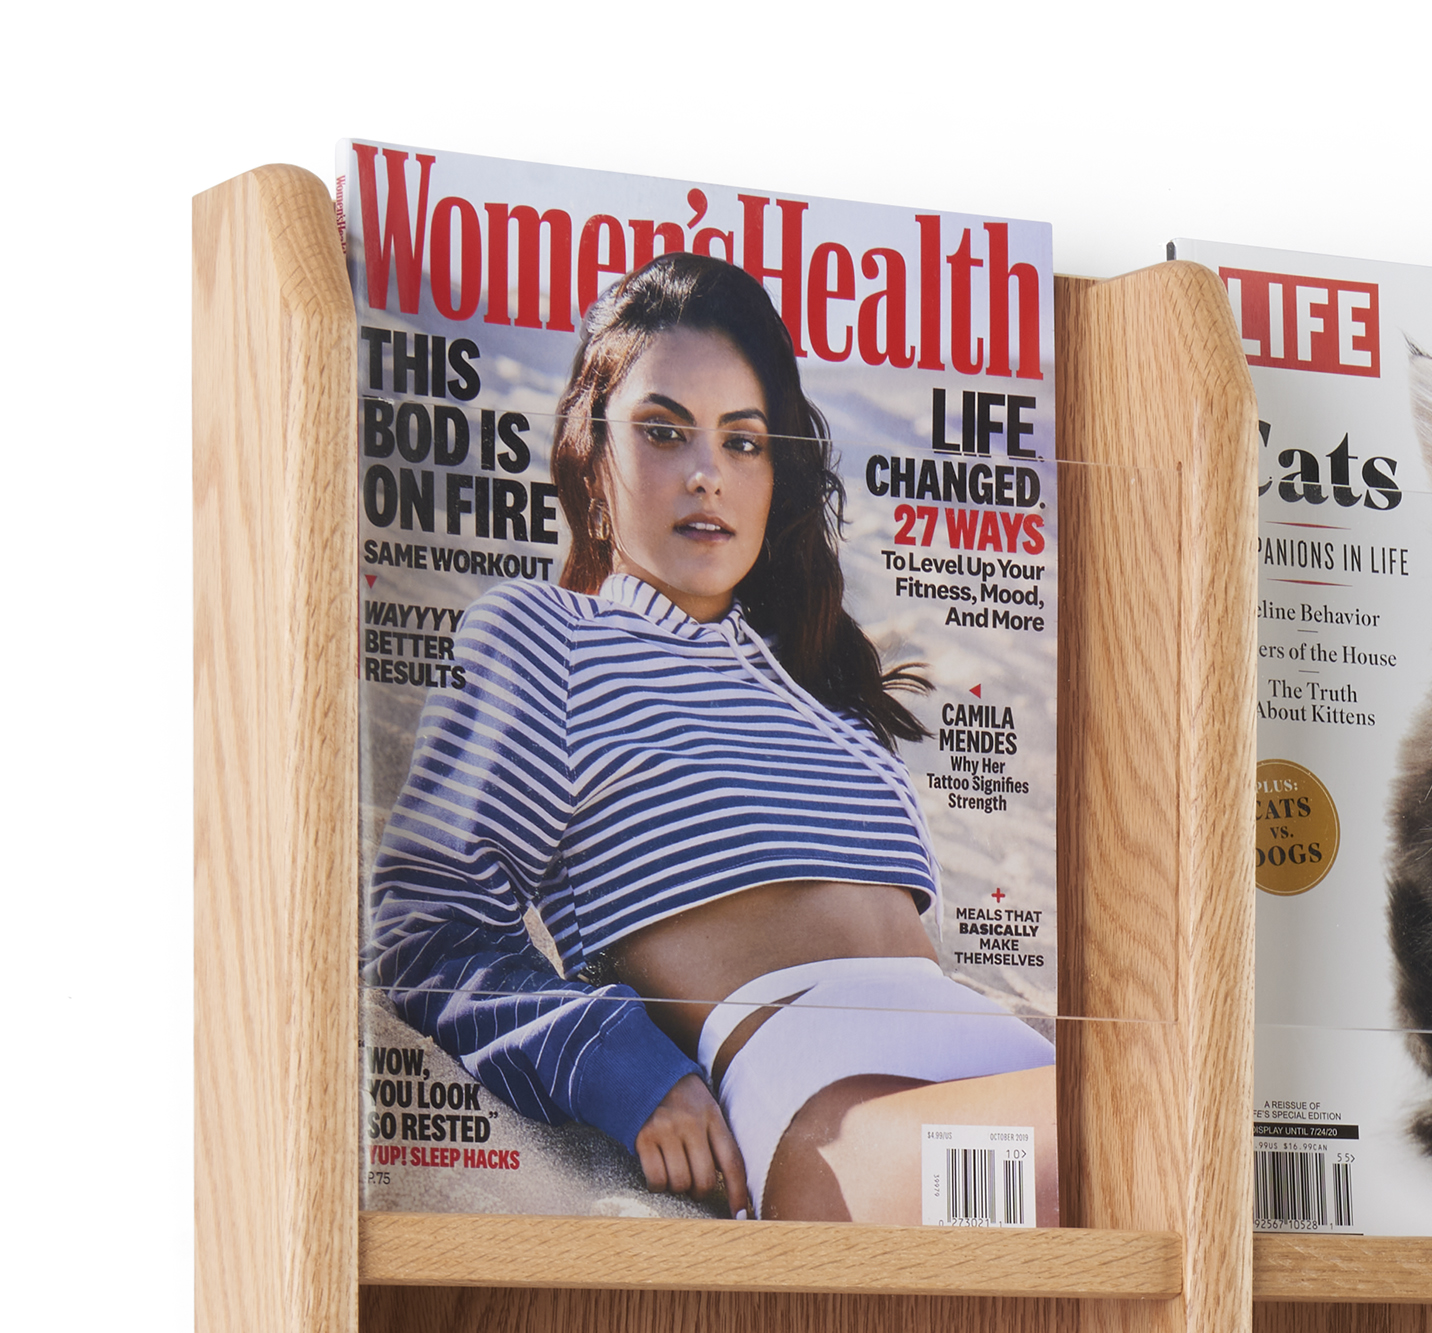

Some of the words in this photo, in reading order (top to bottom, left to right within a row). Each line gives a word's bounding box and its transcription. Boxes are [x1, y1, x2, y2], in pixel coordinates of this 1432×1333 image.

[737, 193, 1044, 381] Health
[1228, 277, 1372, 367] LIFE
[361, 327, 481, 402] THIS
[364, 395, 471, 466] BOD
[480, 408, 530, 473] IS
[931, 388, 1043, 461] LIFE.
[866, 455, 1046, 509] CHANGED.
[364, 466, 442, 534] ON
[447, 473, 558, 545] FIRE
[895, 504, 943, 548] 27
[947, 511, 1045, 554] WAYS
[882, 551, 906, 574] To
[910, 554, 964, 576] Level
[967, 557, 996, 583] Up
[1001, 559, 1044, 579] Your
[1344, 544, 1361, 572] IN
[1372, 547, 1409, 576] LIFE
[1301, 604, 1380, 626] Behavior
[1289, 643, 1307, 660] of
[1310, 644, 1337, 662] the
[1343, 646, 1397, 666] House
[366, 658, 466, 689] RESULTS
[1268, 680, 1302, 699] The
[1307, 682, 1358, 702] Truth
[942, 703, 1014, 729] CAMILA
[1312, 705, 1376, 726] Kittens
[940, 729, 1017, 755] MENDES
[951, 756, 979, 775] Why
[983, 759, 1005, 774] Her
[927, 773, 969, 790] Tattoo
[972, 776, 1029, 795] Signifies
[949, 794, 1007, 813] Strength
[1270, 826, 1294, 839] VS.
[959, 923, 1039, 937] BASICALLY
[955, 952, 1044, 966] THEMSELVES
[1272, 1111, 1306, 1119] SPECIAL
[1308, 1112, 1341, 1120] EDITION
[1286, 1128, 1308, 1136] UNTIL
[1310, 1128, 1337, 1136] 7/24/20
[410, 1147, 460, 1167] SLEEP
[464, 1149, 520, 1170] HACKS
